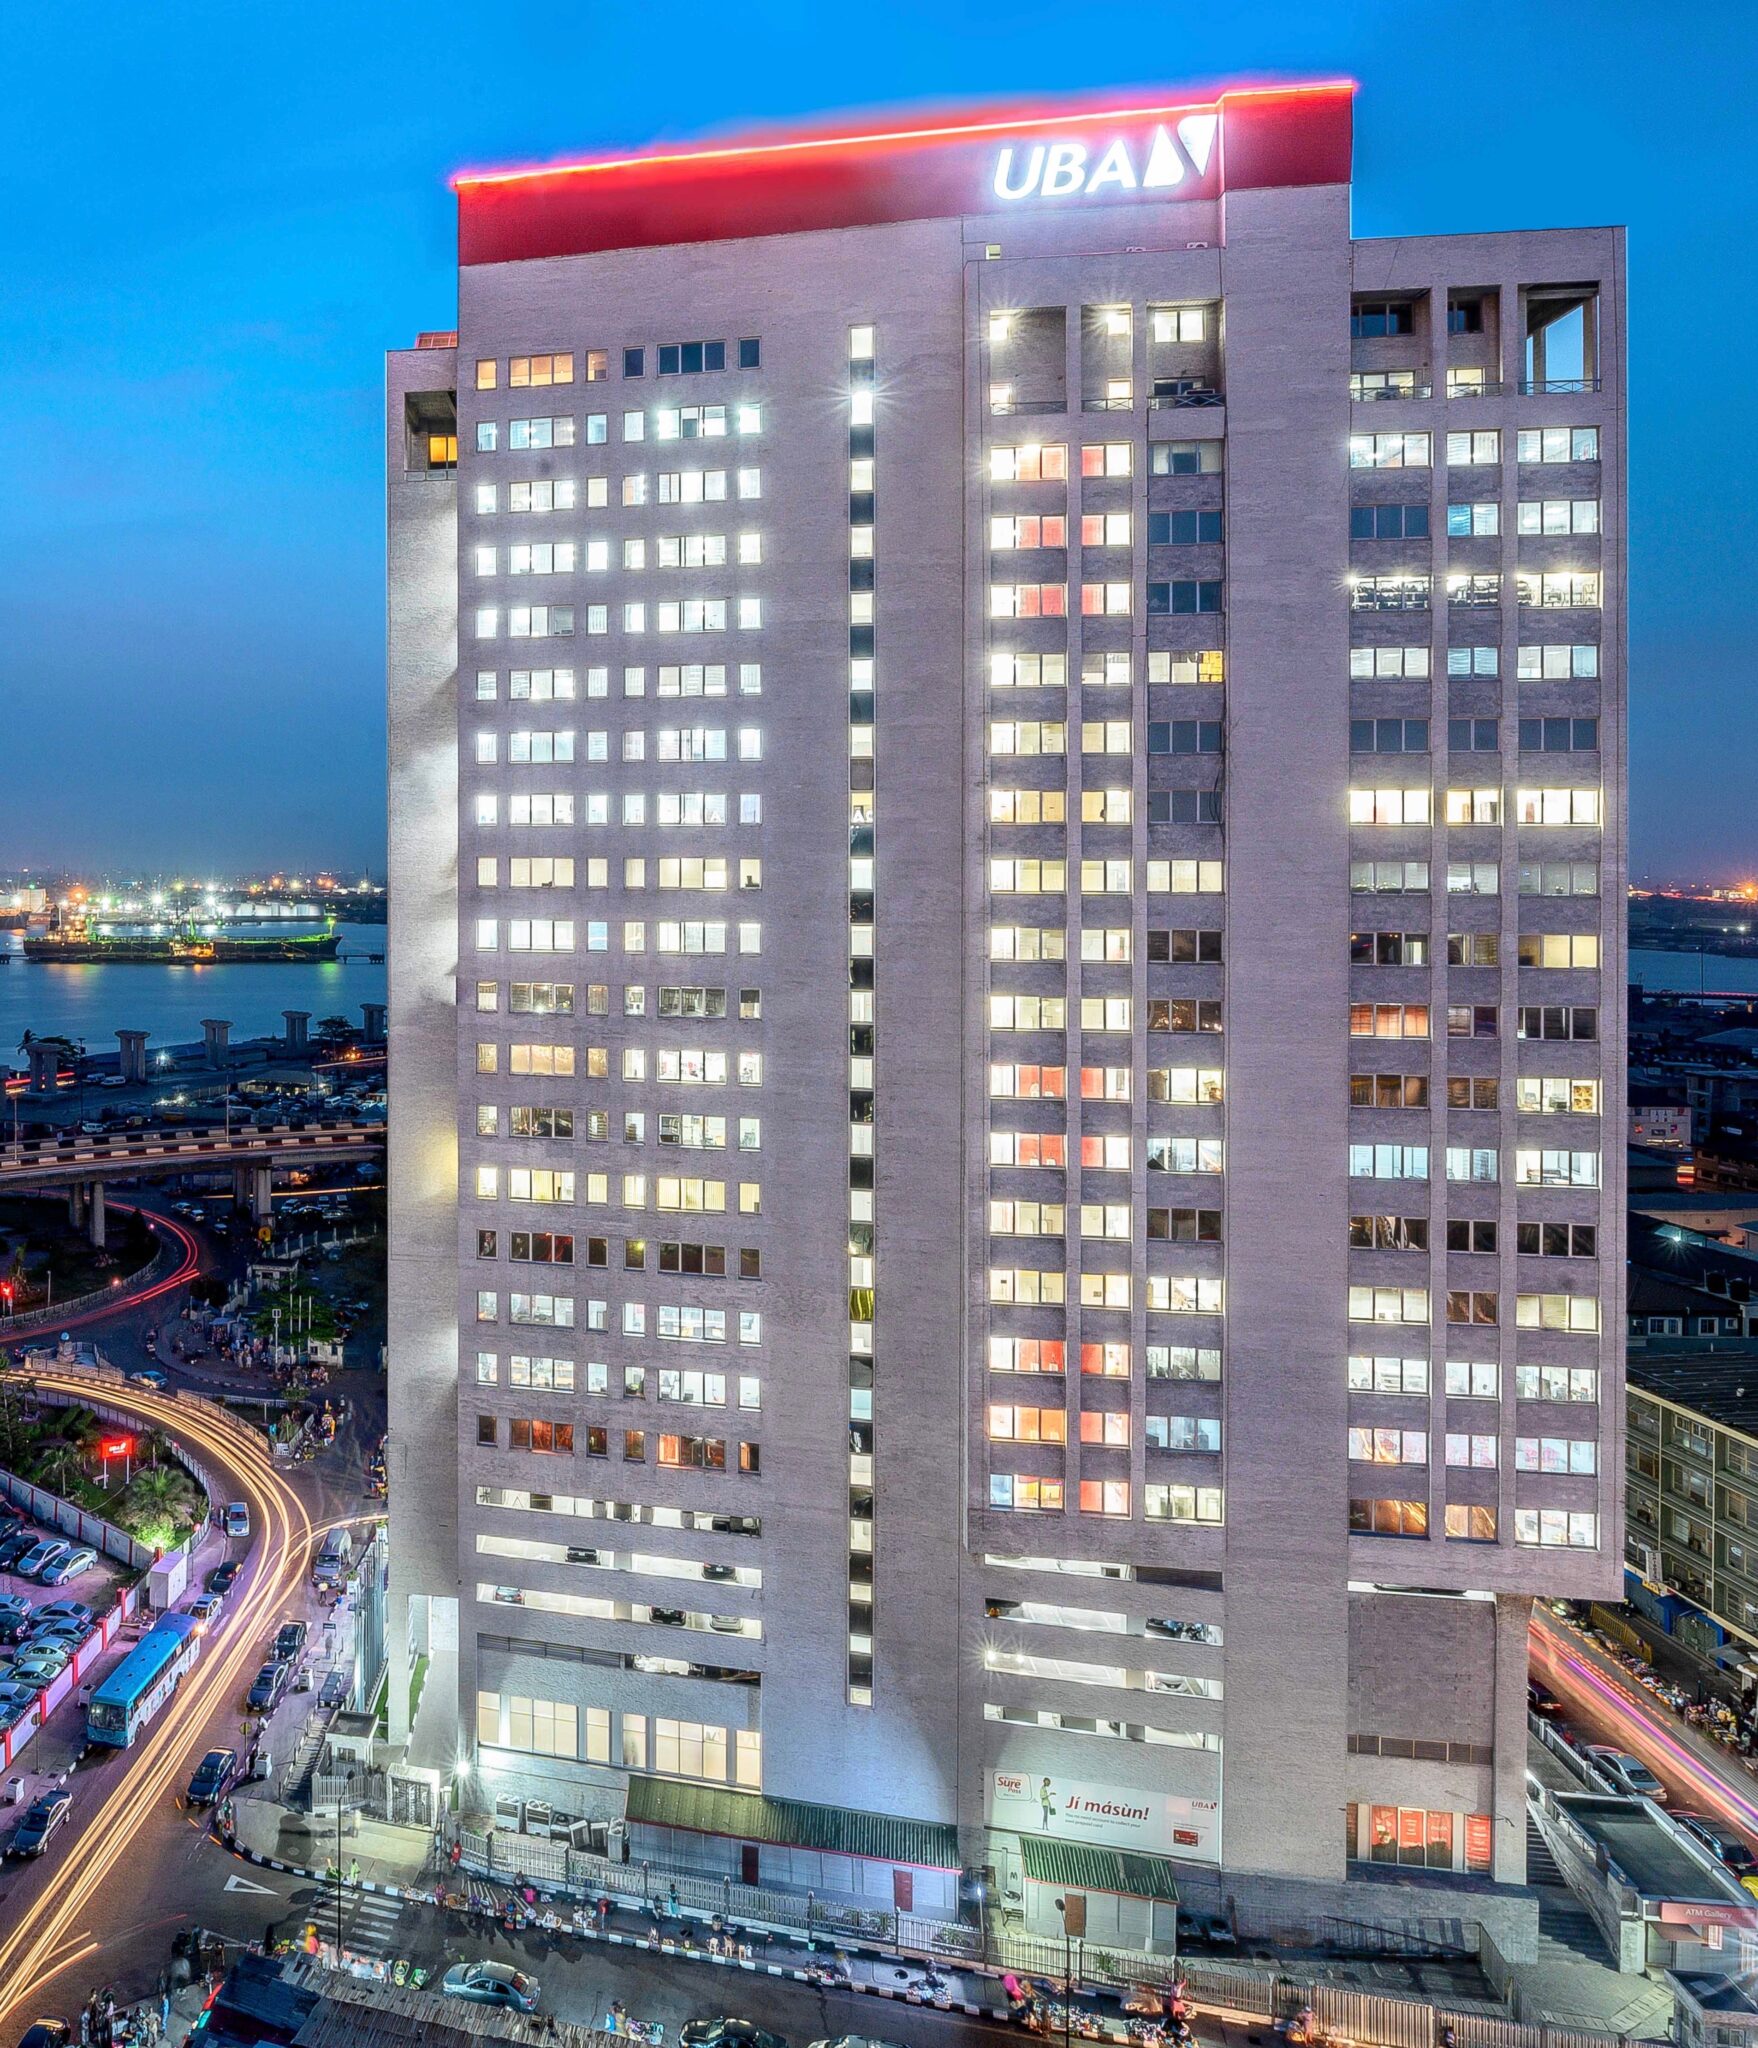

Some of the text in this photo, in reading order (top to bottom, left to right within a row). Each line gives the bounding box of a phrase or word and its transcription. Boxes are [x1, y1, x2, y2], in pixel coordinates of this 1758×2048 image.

[992, 139, 1137, 200] UBA
[997, 1777, 1022, 1789] Sure
[1065, 1796, 1150, 1820] Jí másùn!
[1191, 1800, 1209, 1809] UBA
[1685, 1908, 1703, 1917] ATM
[1704, 1909, 1732, 1919] Gallery
